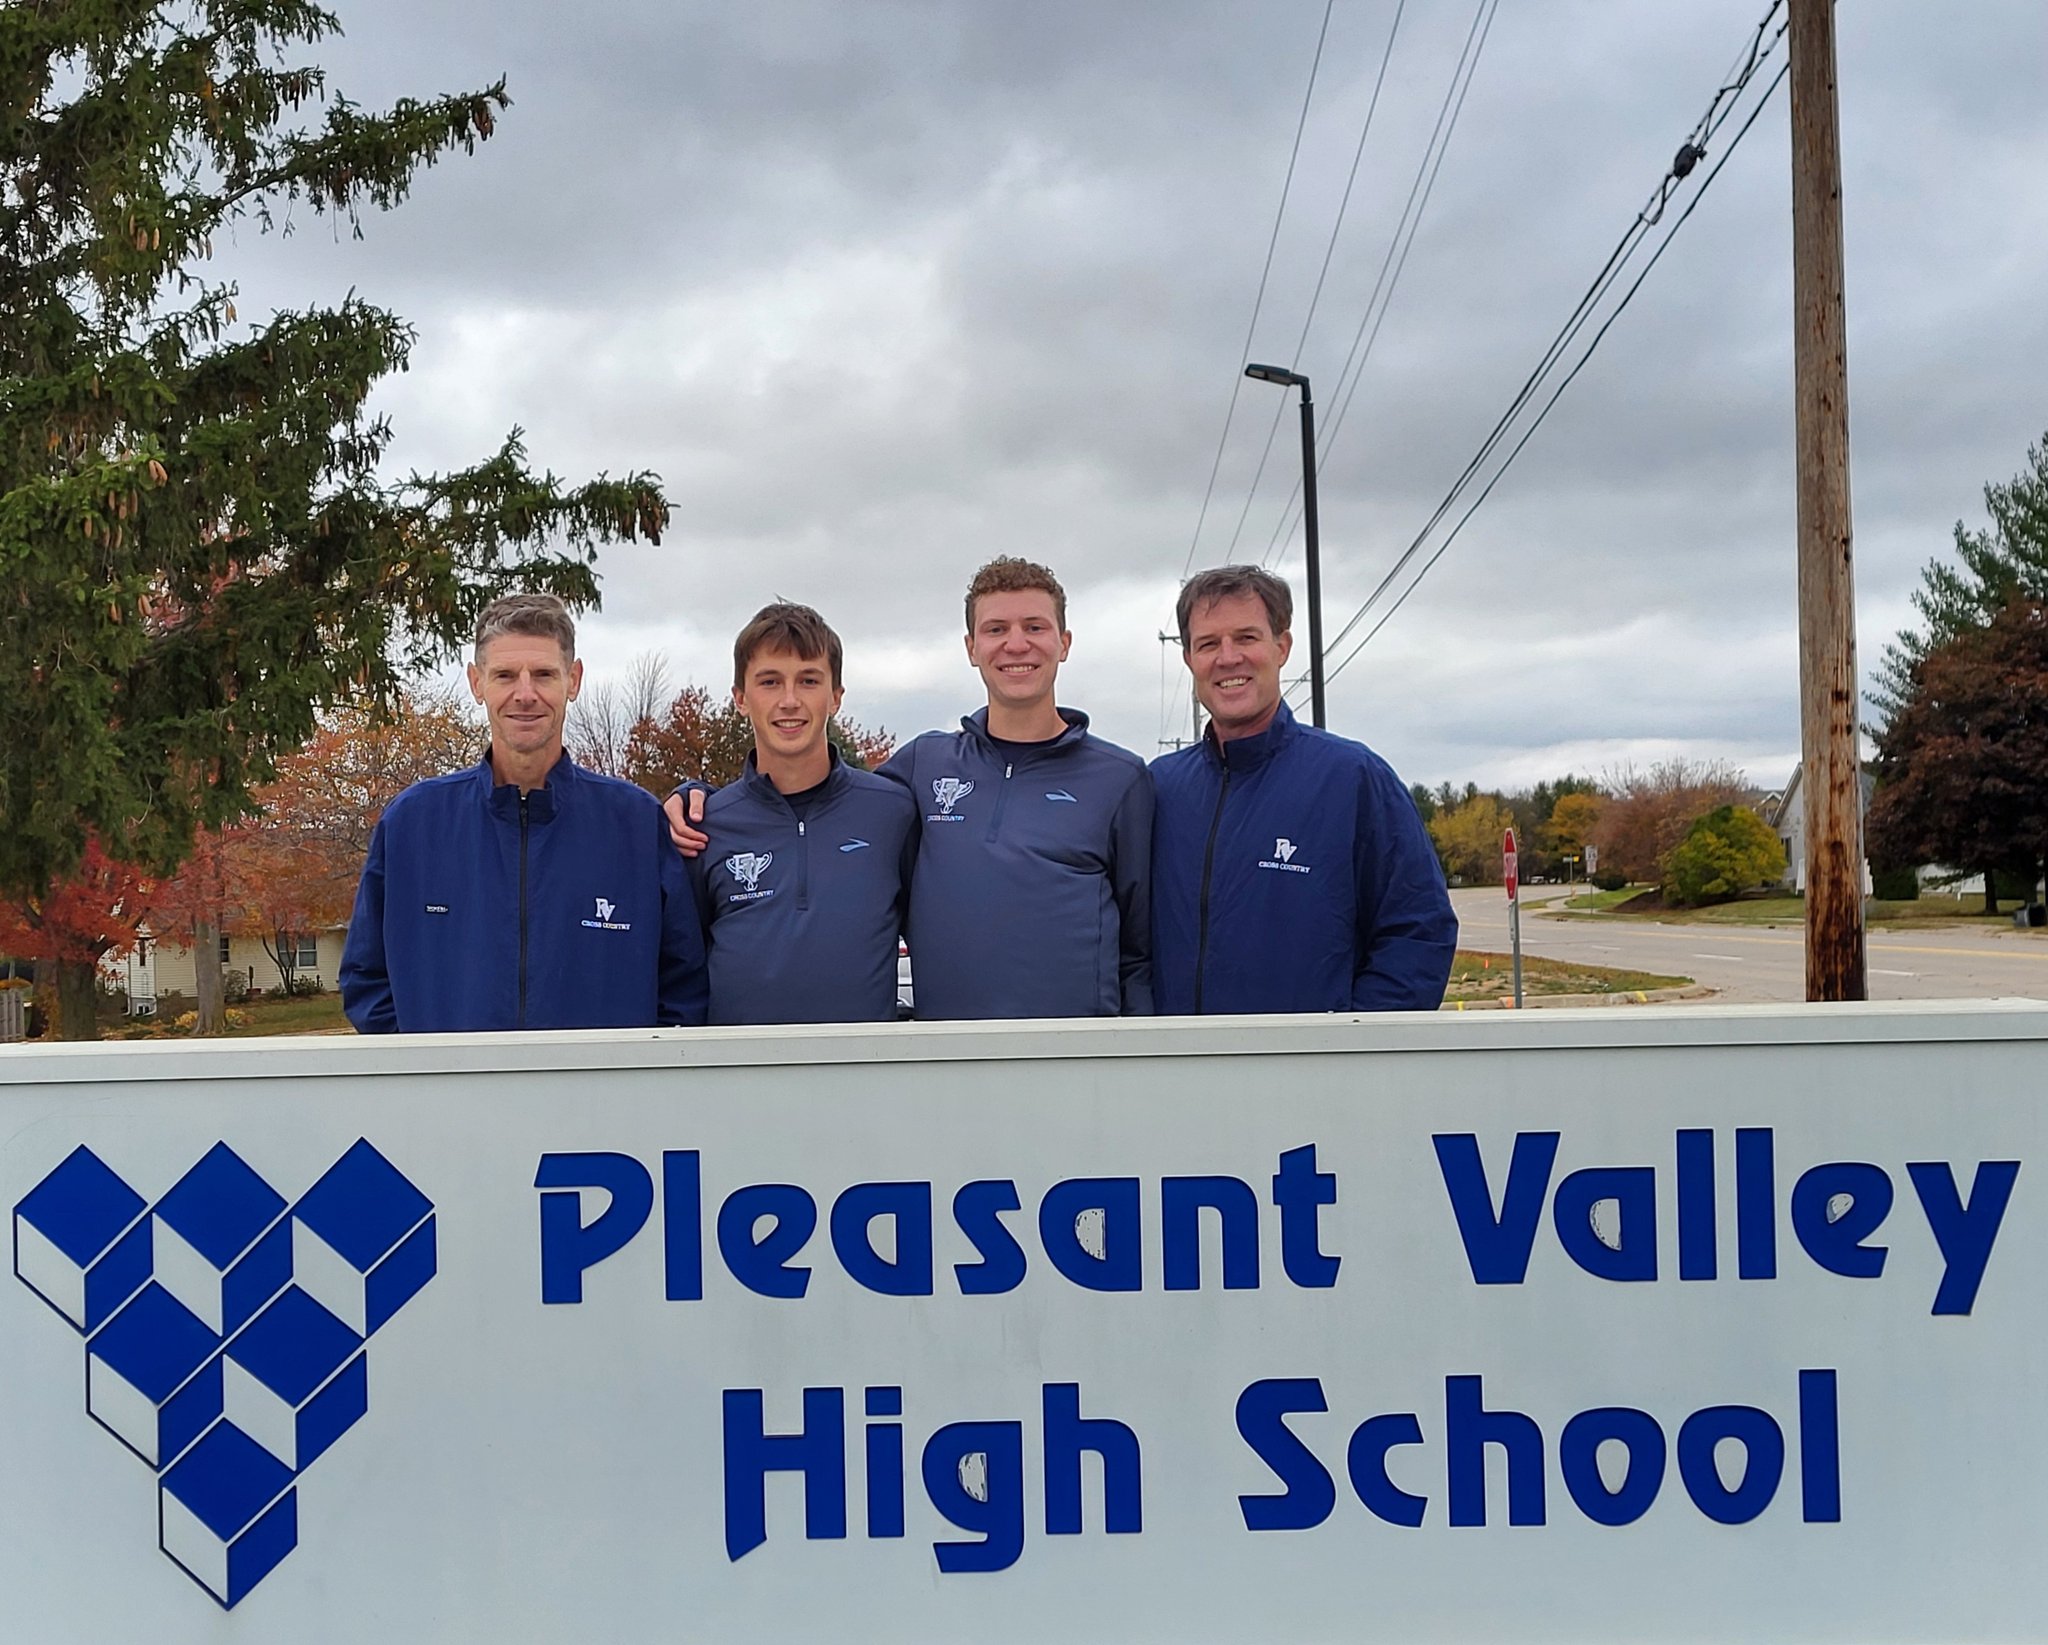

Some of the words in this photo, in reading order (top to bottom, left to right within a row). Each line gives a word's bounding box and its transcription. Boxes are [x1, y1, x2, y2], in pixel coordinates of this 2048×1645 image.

[748, 889, 774, 899] COUNTRY
[1258, 861, 1280, 869] CROSS
[1280, 863, 1311, 873] COUNTRY
[534, 1145, 1342, 1304] Pleasant
[1432, 1128, 2020, 1316] Valley
[722, 1383, 1142, 1574] High
[1236, 1370, 1841, 1531] School
